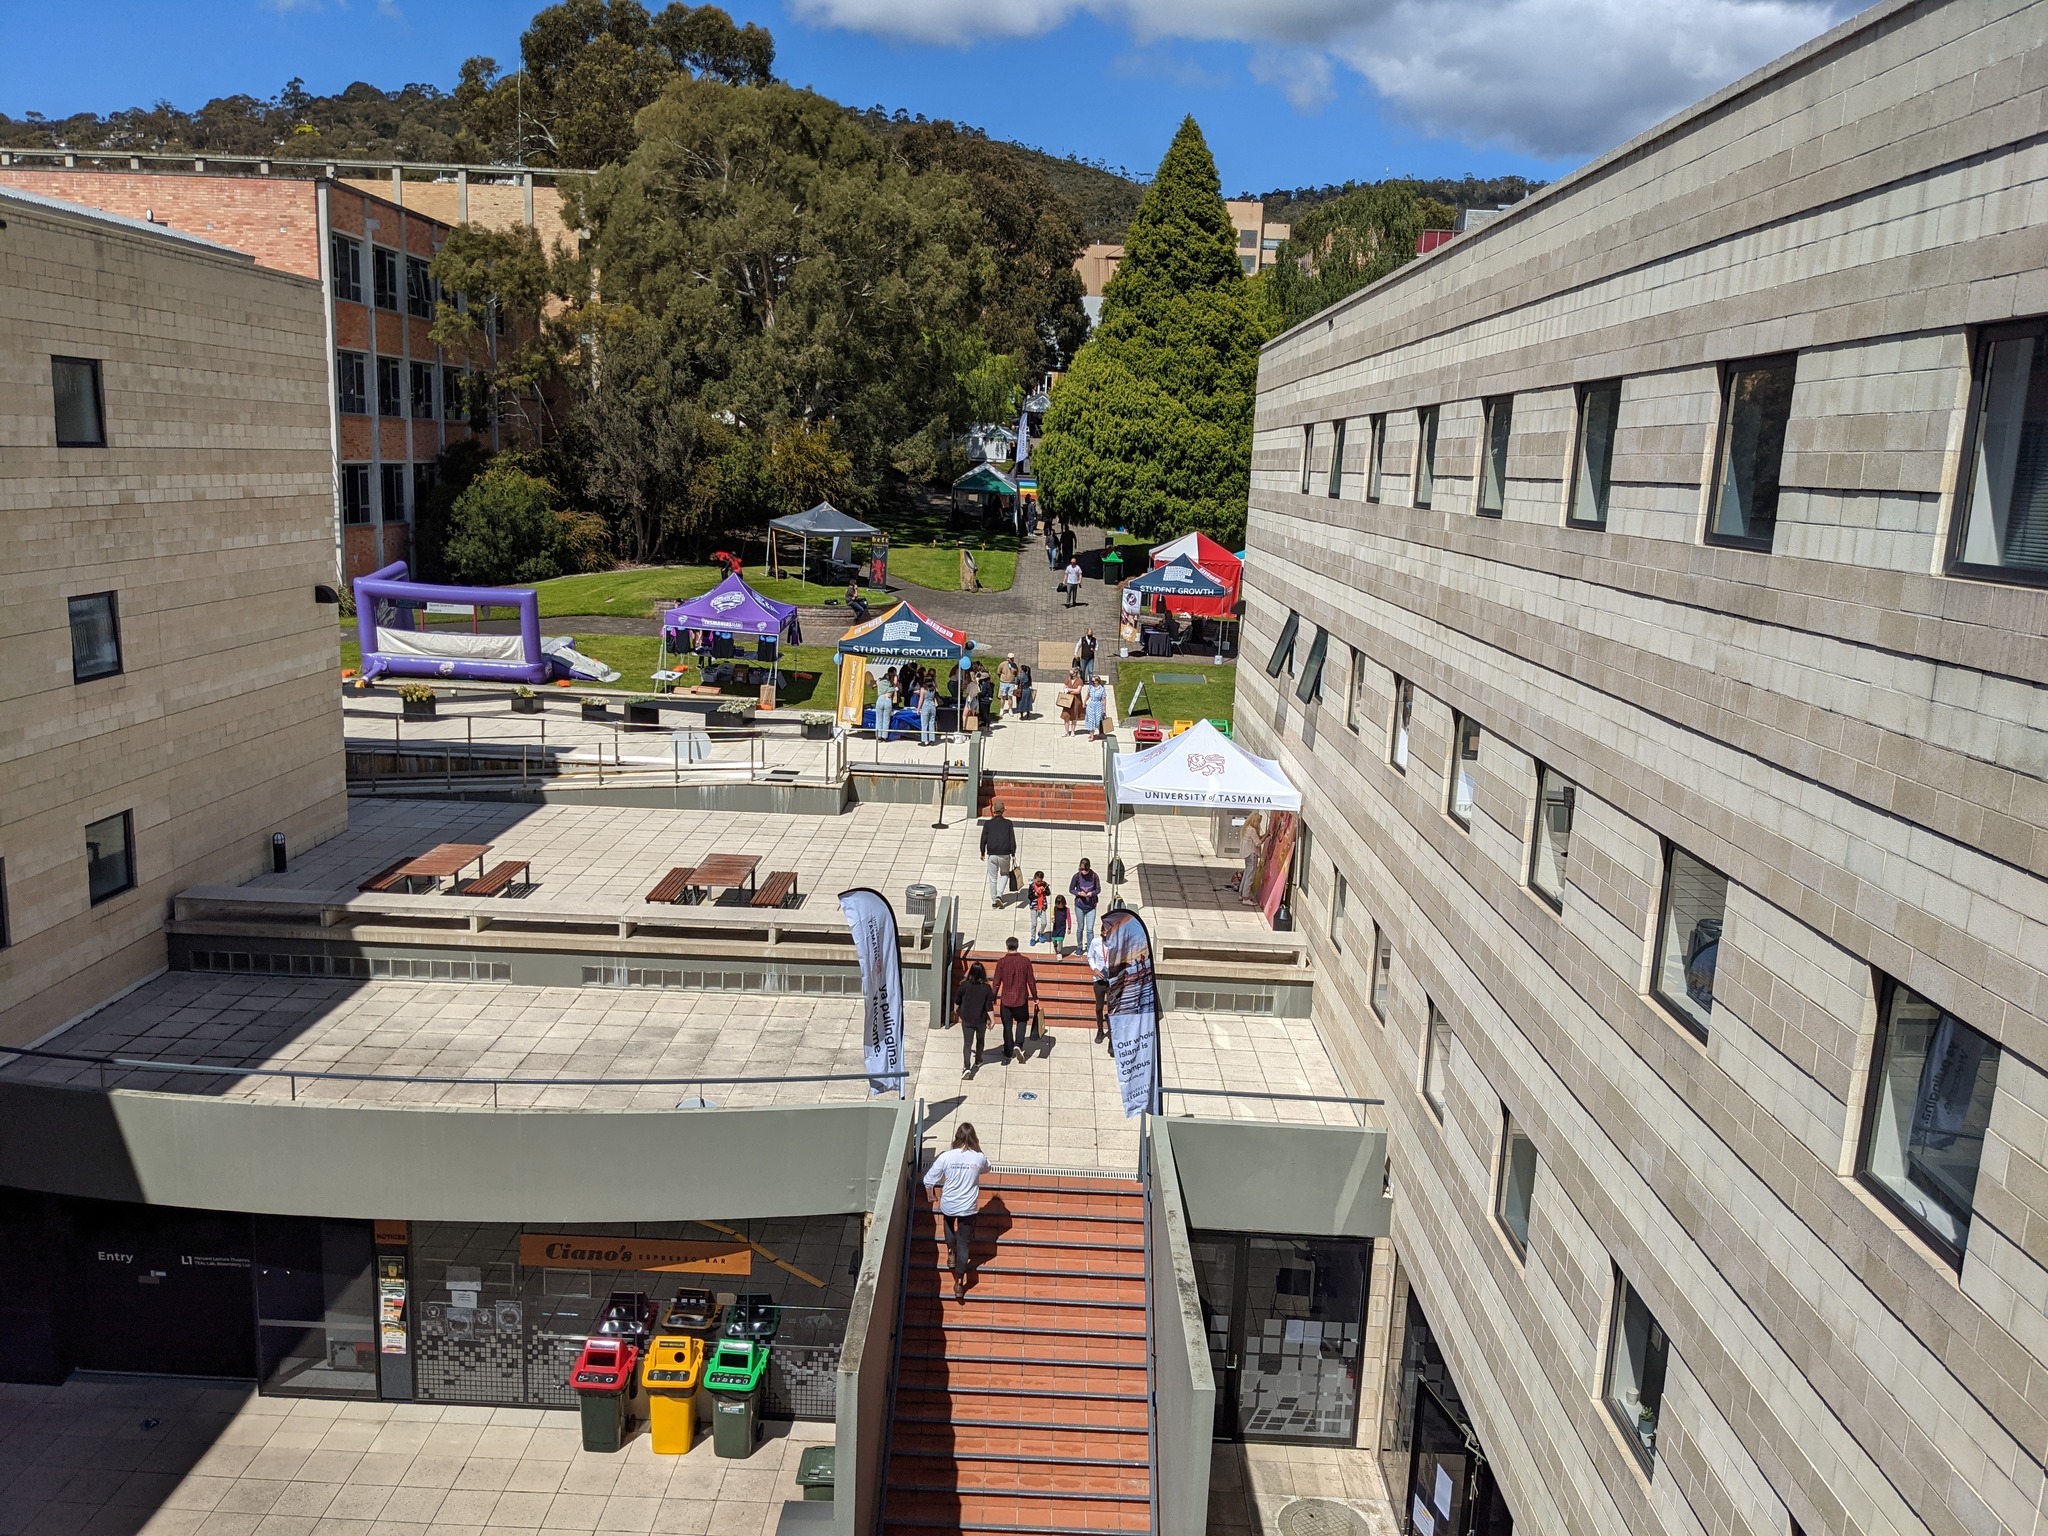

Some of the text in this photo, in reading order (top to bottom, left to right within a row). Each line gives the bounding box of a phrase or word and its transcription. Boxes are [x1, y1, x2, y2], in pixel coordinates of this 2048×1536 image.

[1140, 585, 1214, 595] STUDENT GROWTH
[853, 645, 948, 657] STUDENT GROWTH
[1145, 792, 1272, 803] UNIVERSITY of TASMANIA
[879, 984, 898, 1068] ya pulingina.
[1118, 1040, 1132, 1049] Our
[1119, 1044, 1140, 1058] island
[1122, 1060, 1150, 1075] campus
[1126, 1089, 1149, 1101] TASMAN
[98, 1252, 133, 1264] Entry
[546, 1243, 633, 1262] Ciano's
[182, 1256, 192, 1265] L1
